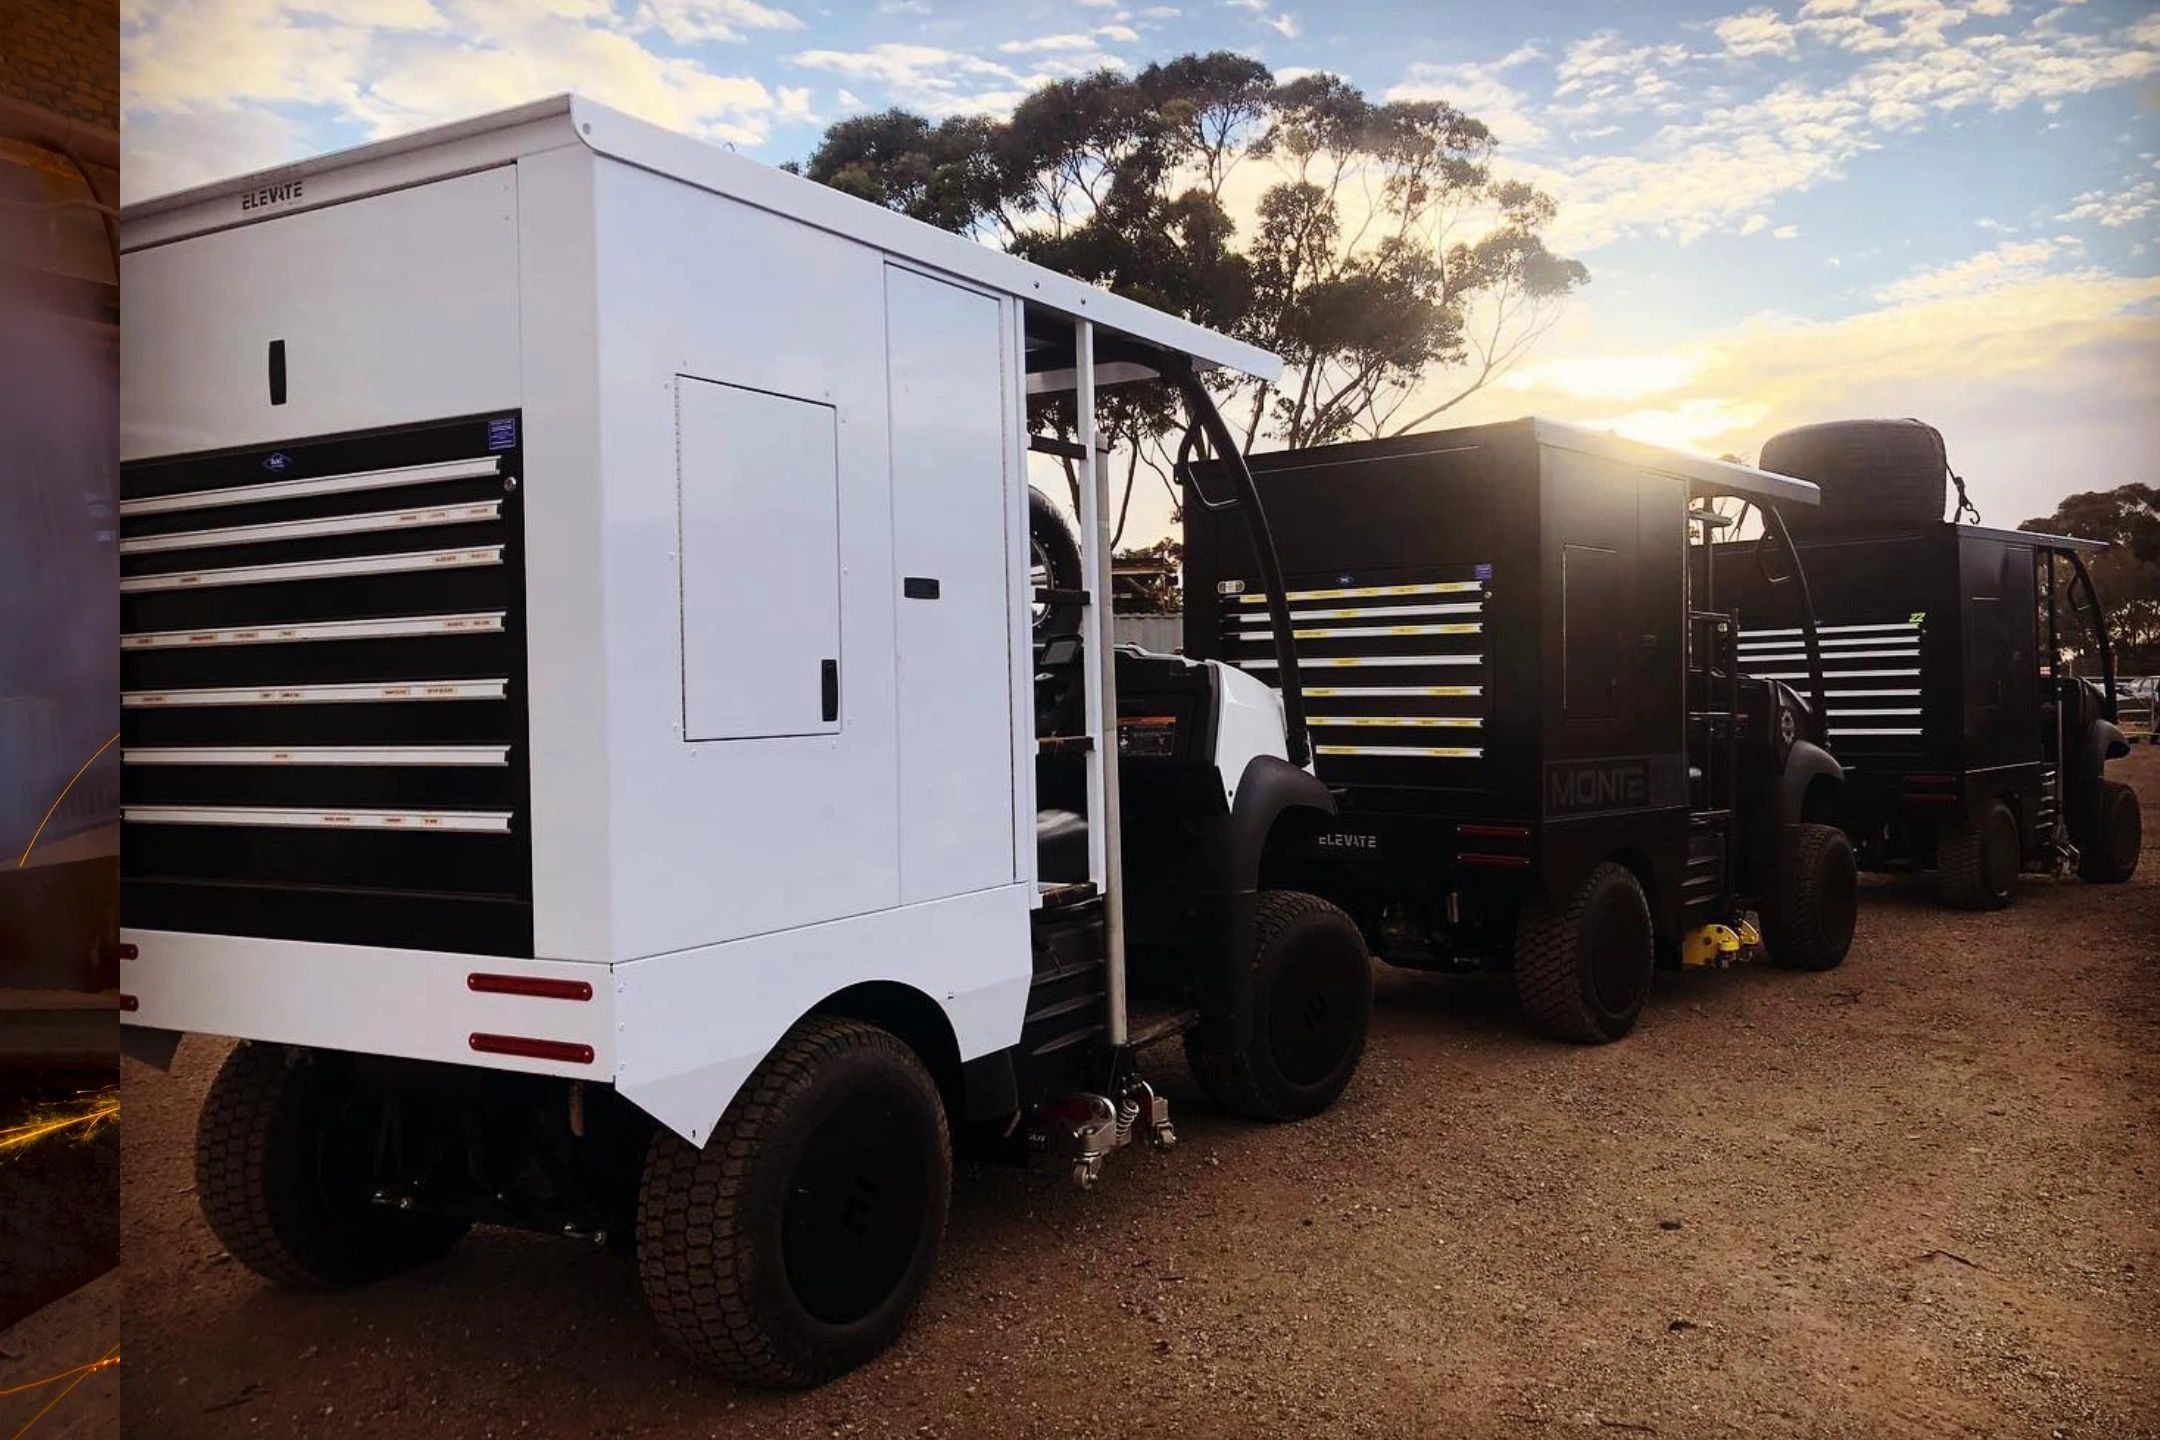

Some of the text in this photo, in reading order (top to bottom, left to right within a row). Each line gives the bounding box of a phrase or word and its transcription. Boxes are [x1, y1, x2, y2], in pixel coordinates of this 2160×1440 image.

[242, 181, 303, 210] ELEVATE
[1551, 766, 1645, 807] MONTE
[1318, 833, 1377, 848] ELEVATE
